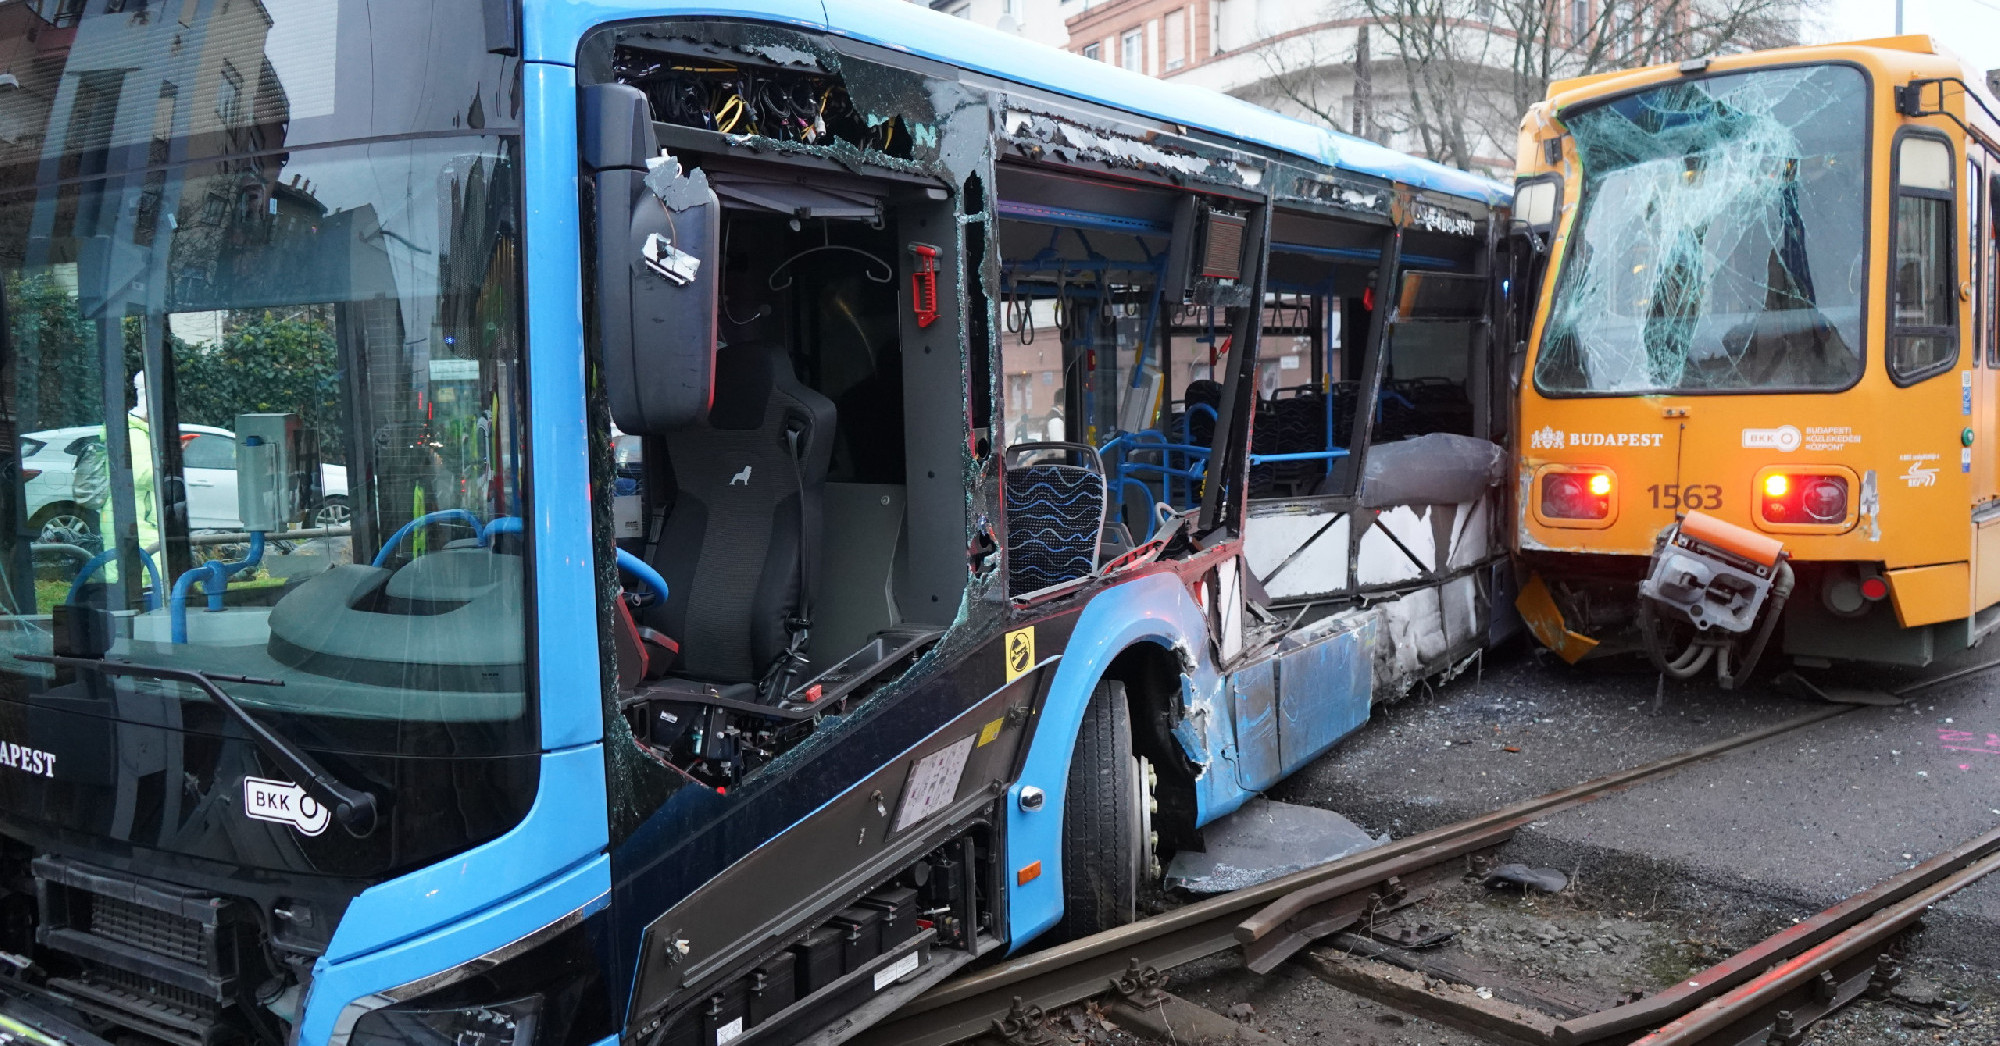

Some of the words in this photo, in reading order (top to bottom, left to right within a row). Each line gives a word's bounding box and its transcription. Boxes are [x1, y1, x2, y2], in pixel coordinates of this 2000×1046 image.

[1750, 433, 1774, 442] BKK
[1806, 427, 1852, 435] BUDAPESTI
[1569, 433, 1663, 447] BUDAPEST
[1646, 484, 1723, 510] 1563
[256, 790, 290, 811] BKK
